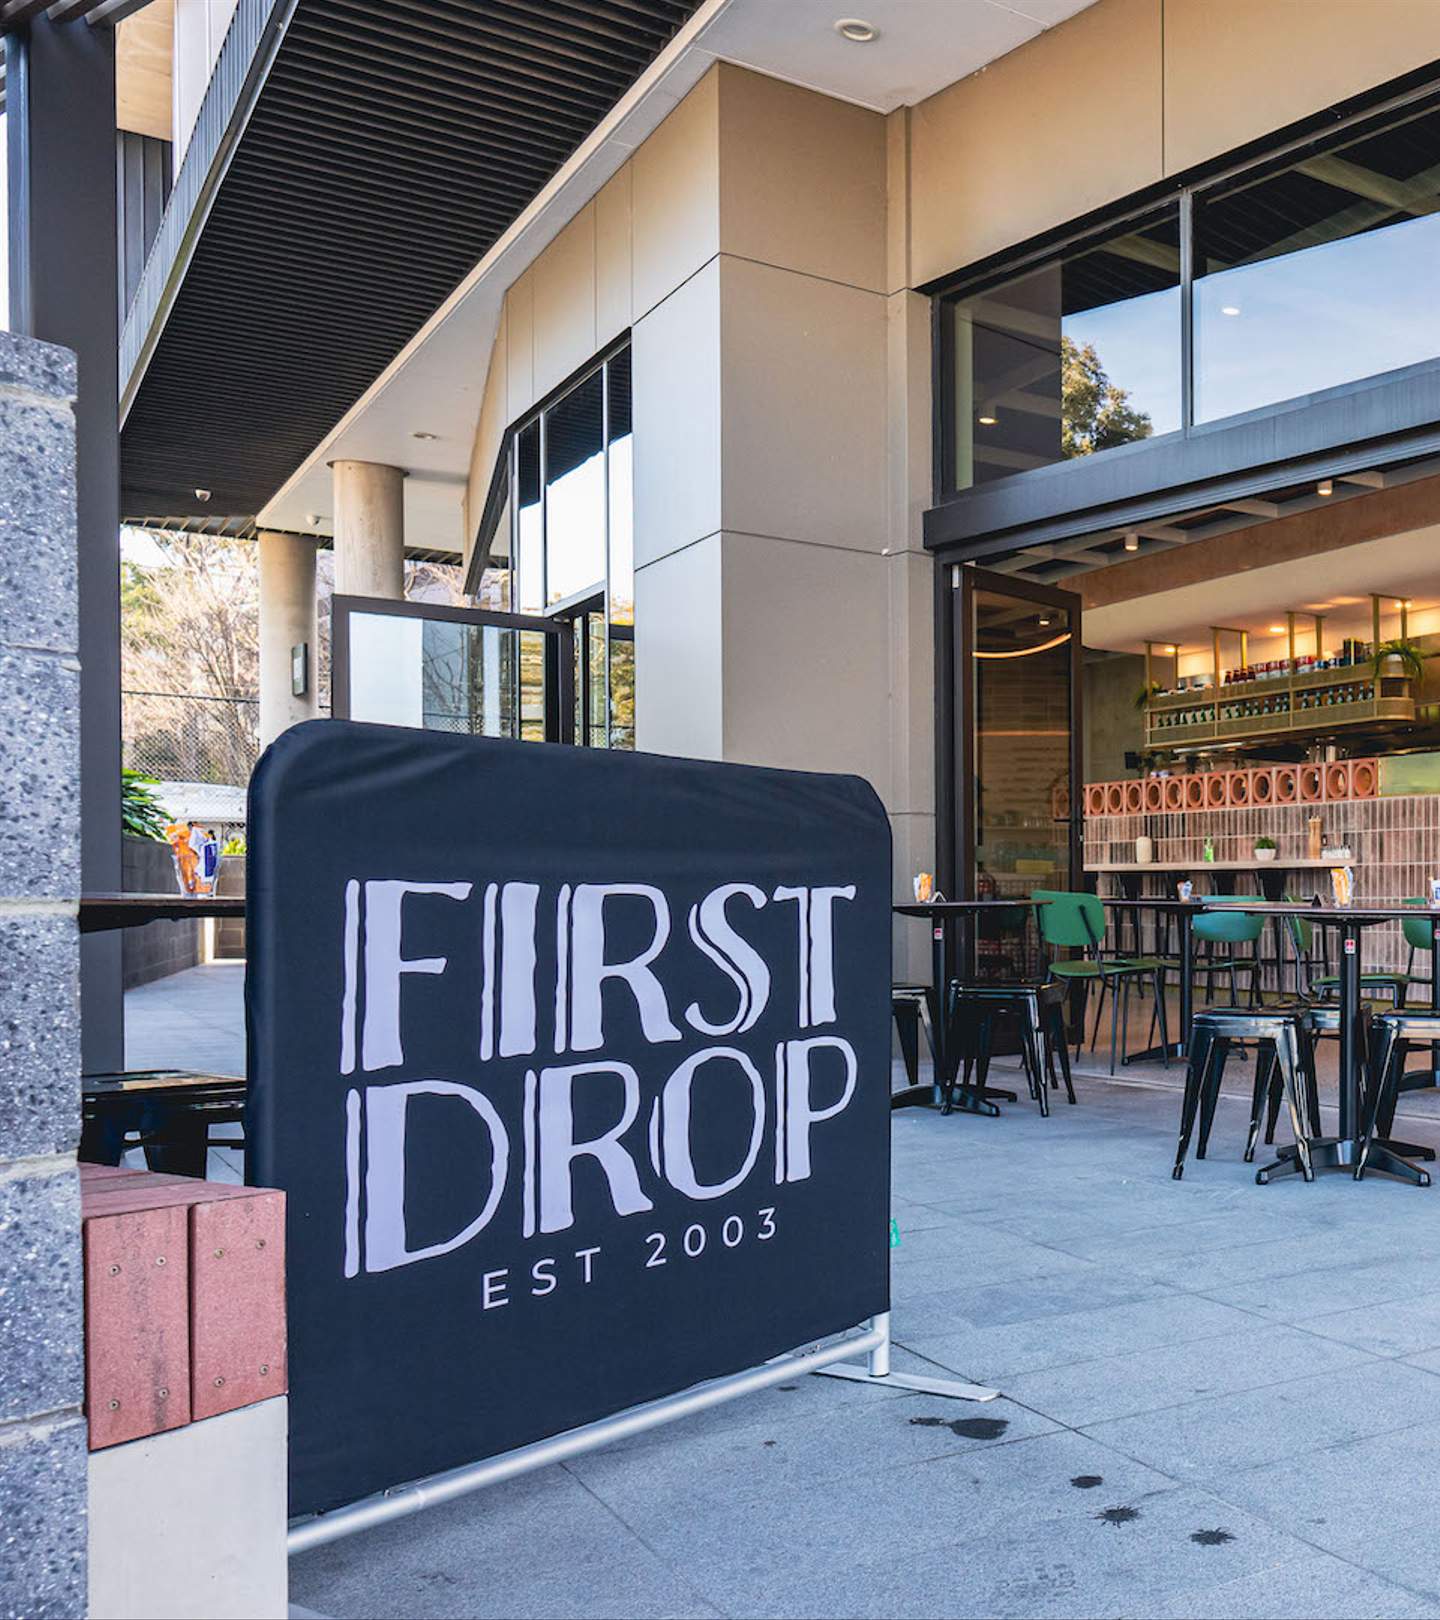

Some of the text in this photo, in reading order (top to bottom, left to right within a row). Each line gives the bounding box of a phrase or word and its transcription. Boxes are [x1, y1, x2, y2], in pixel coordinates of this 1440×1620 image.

[341, 879, 857, 1075] FIRST
[345, 1036, 858, 1278] DROP
[483, 1207, 777, 1310] EST 2003
